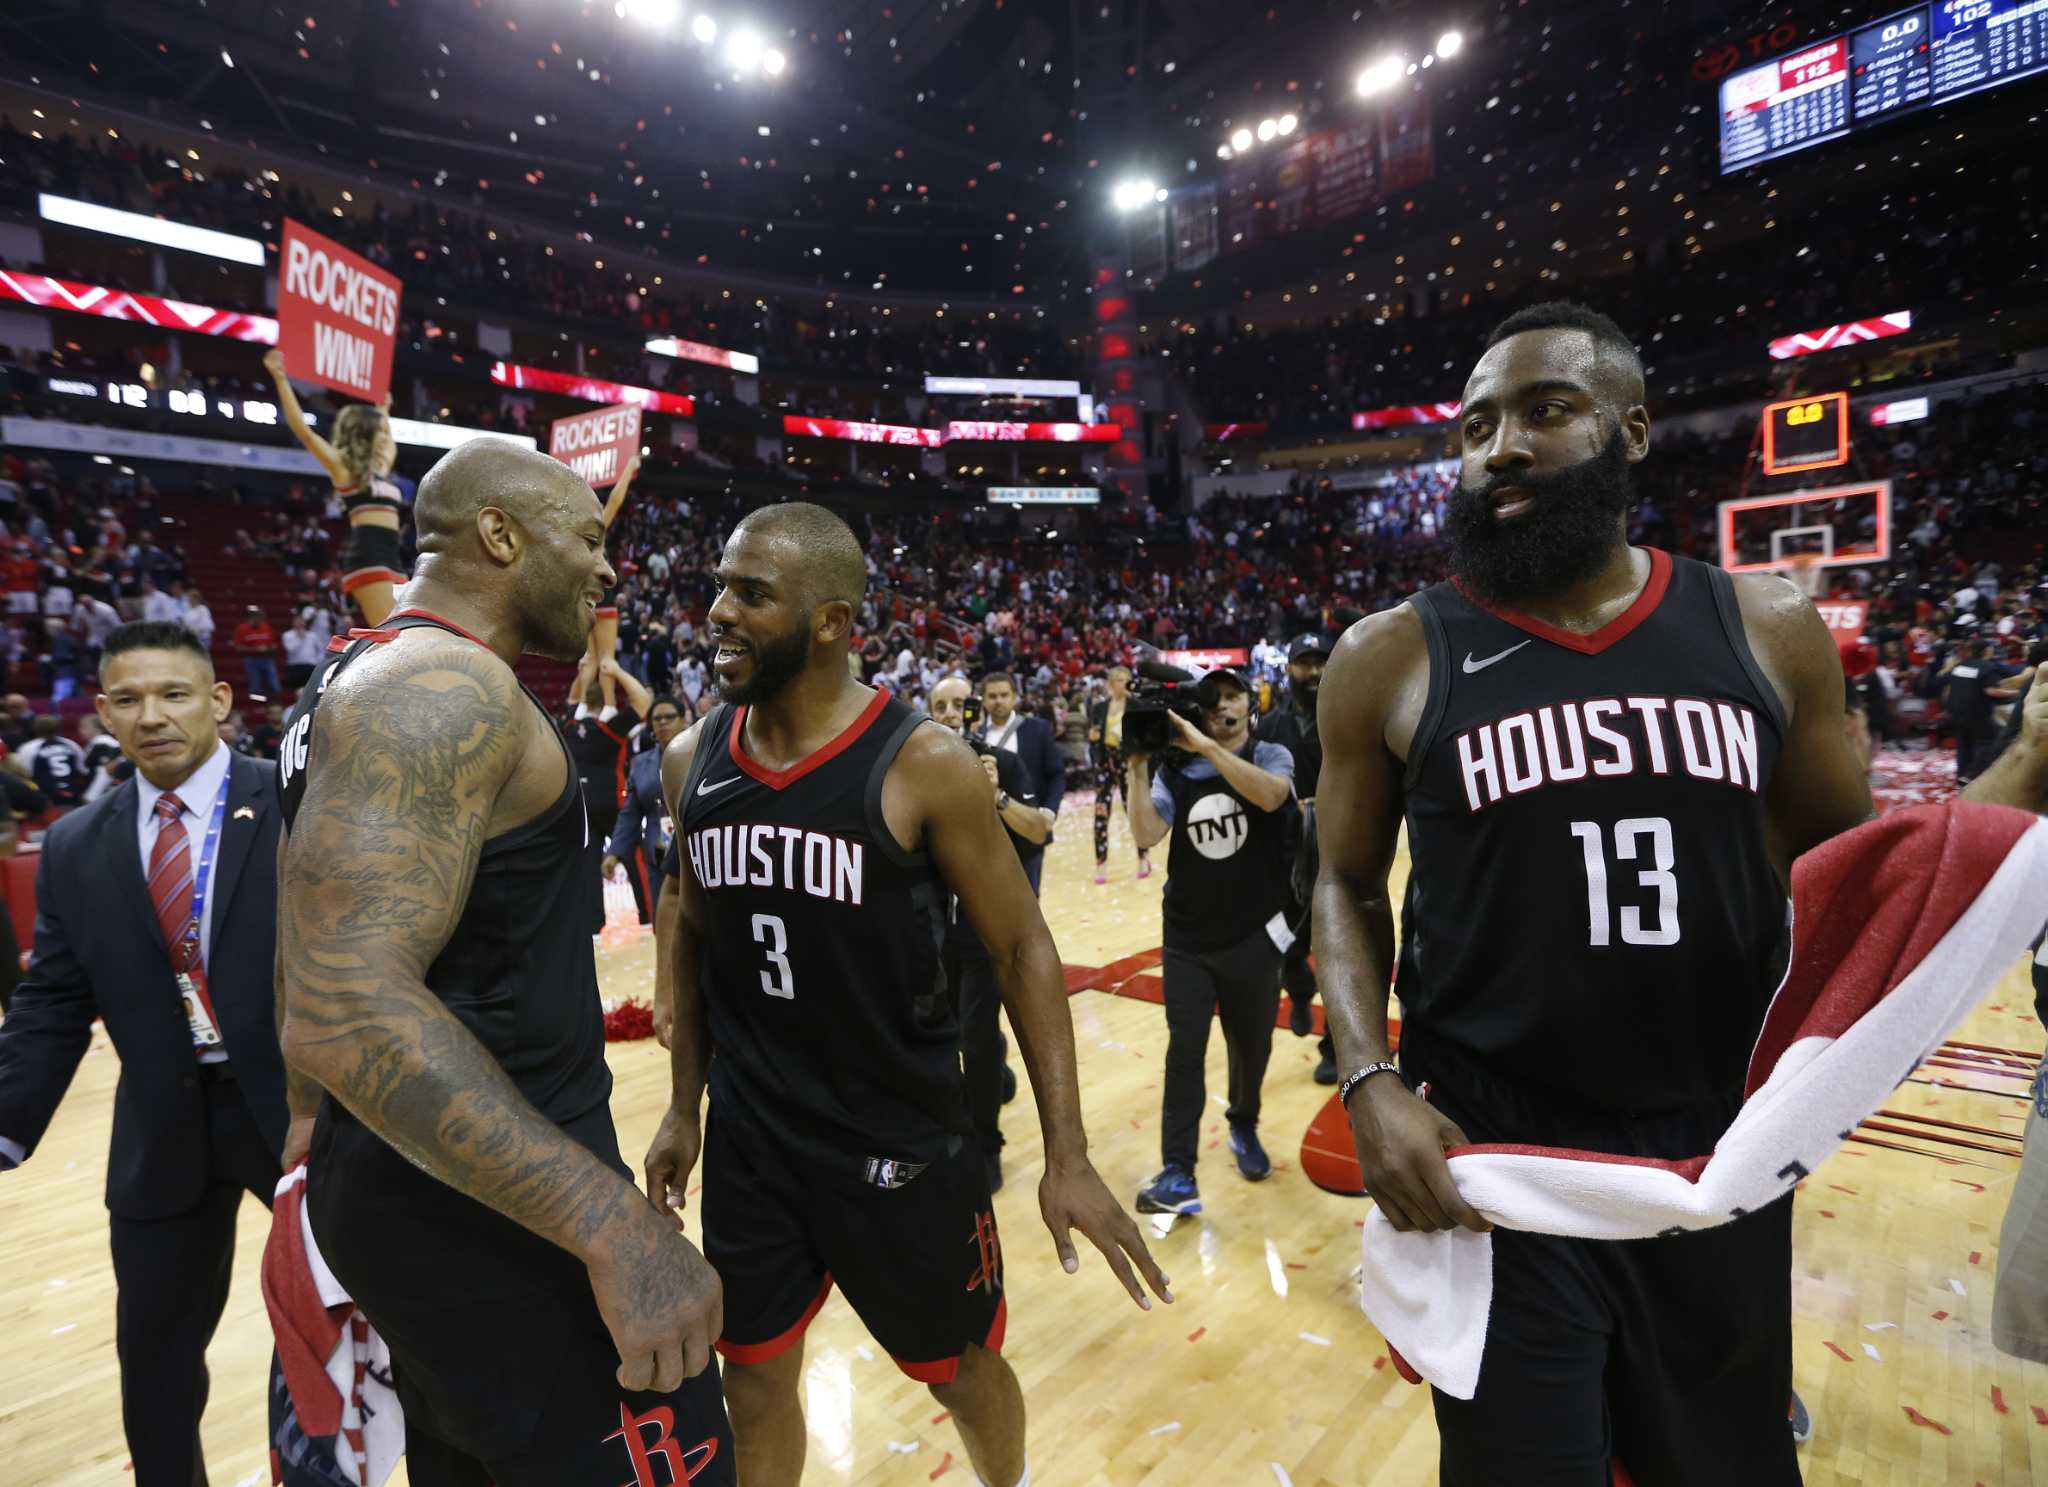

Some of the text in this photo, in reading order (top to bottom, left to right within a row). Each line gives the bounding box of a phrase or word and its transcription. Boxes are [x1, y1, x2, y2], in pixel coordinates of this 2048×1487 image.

[1881, 17, 1919, 42] 0.0
[1952, 1, 1992, 26] 102
[1795, 60, 1831, 83] 112
[286, 238, 398, 336] ROCKETS
[314, 320, 375, 391] WIN!!
[553, 407, 638, 453] ROCKETS
[570, 448, 618, 482] WIN!!
[1457, 697, 1758, 812] HOUSTON
[1187, 811, 1248, 844] TNT
[688, 825, 863, 905] HOUSTON
[1570, 816, 1681, 946] 13
[752, 913, 795, 1000] 3
[1350, 1073, 1359, 1084] IS
[1360, 1064, 1378, 1077] BIG
